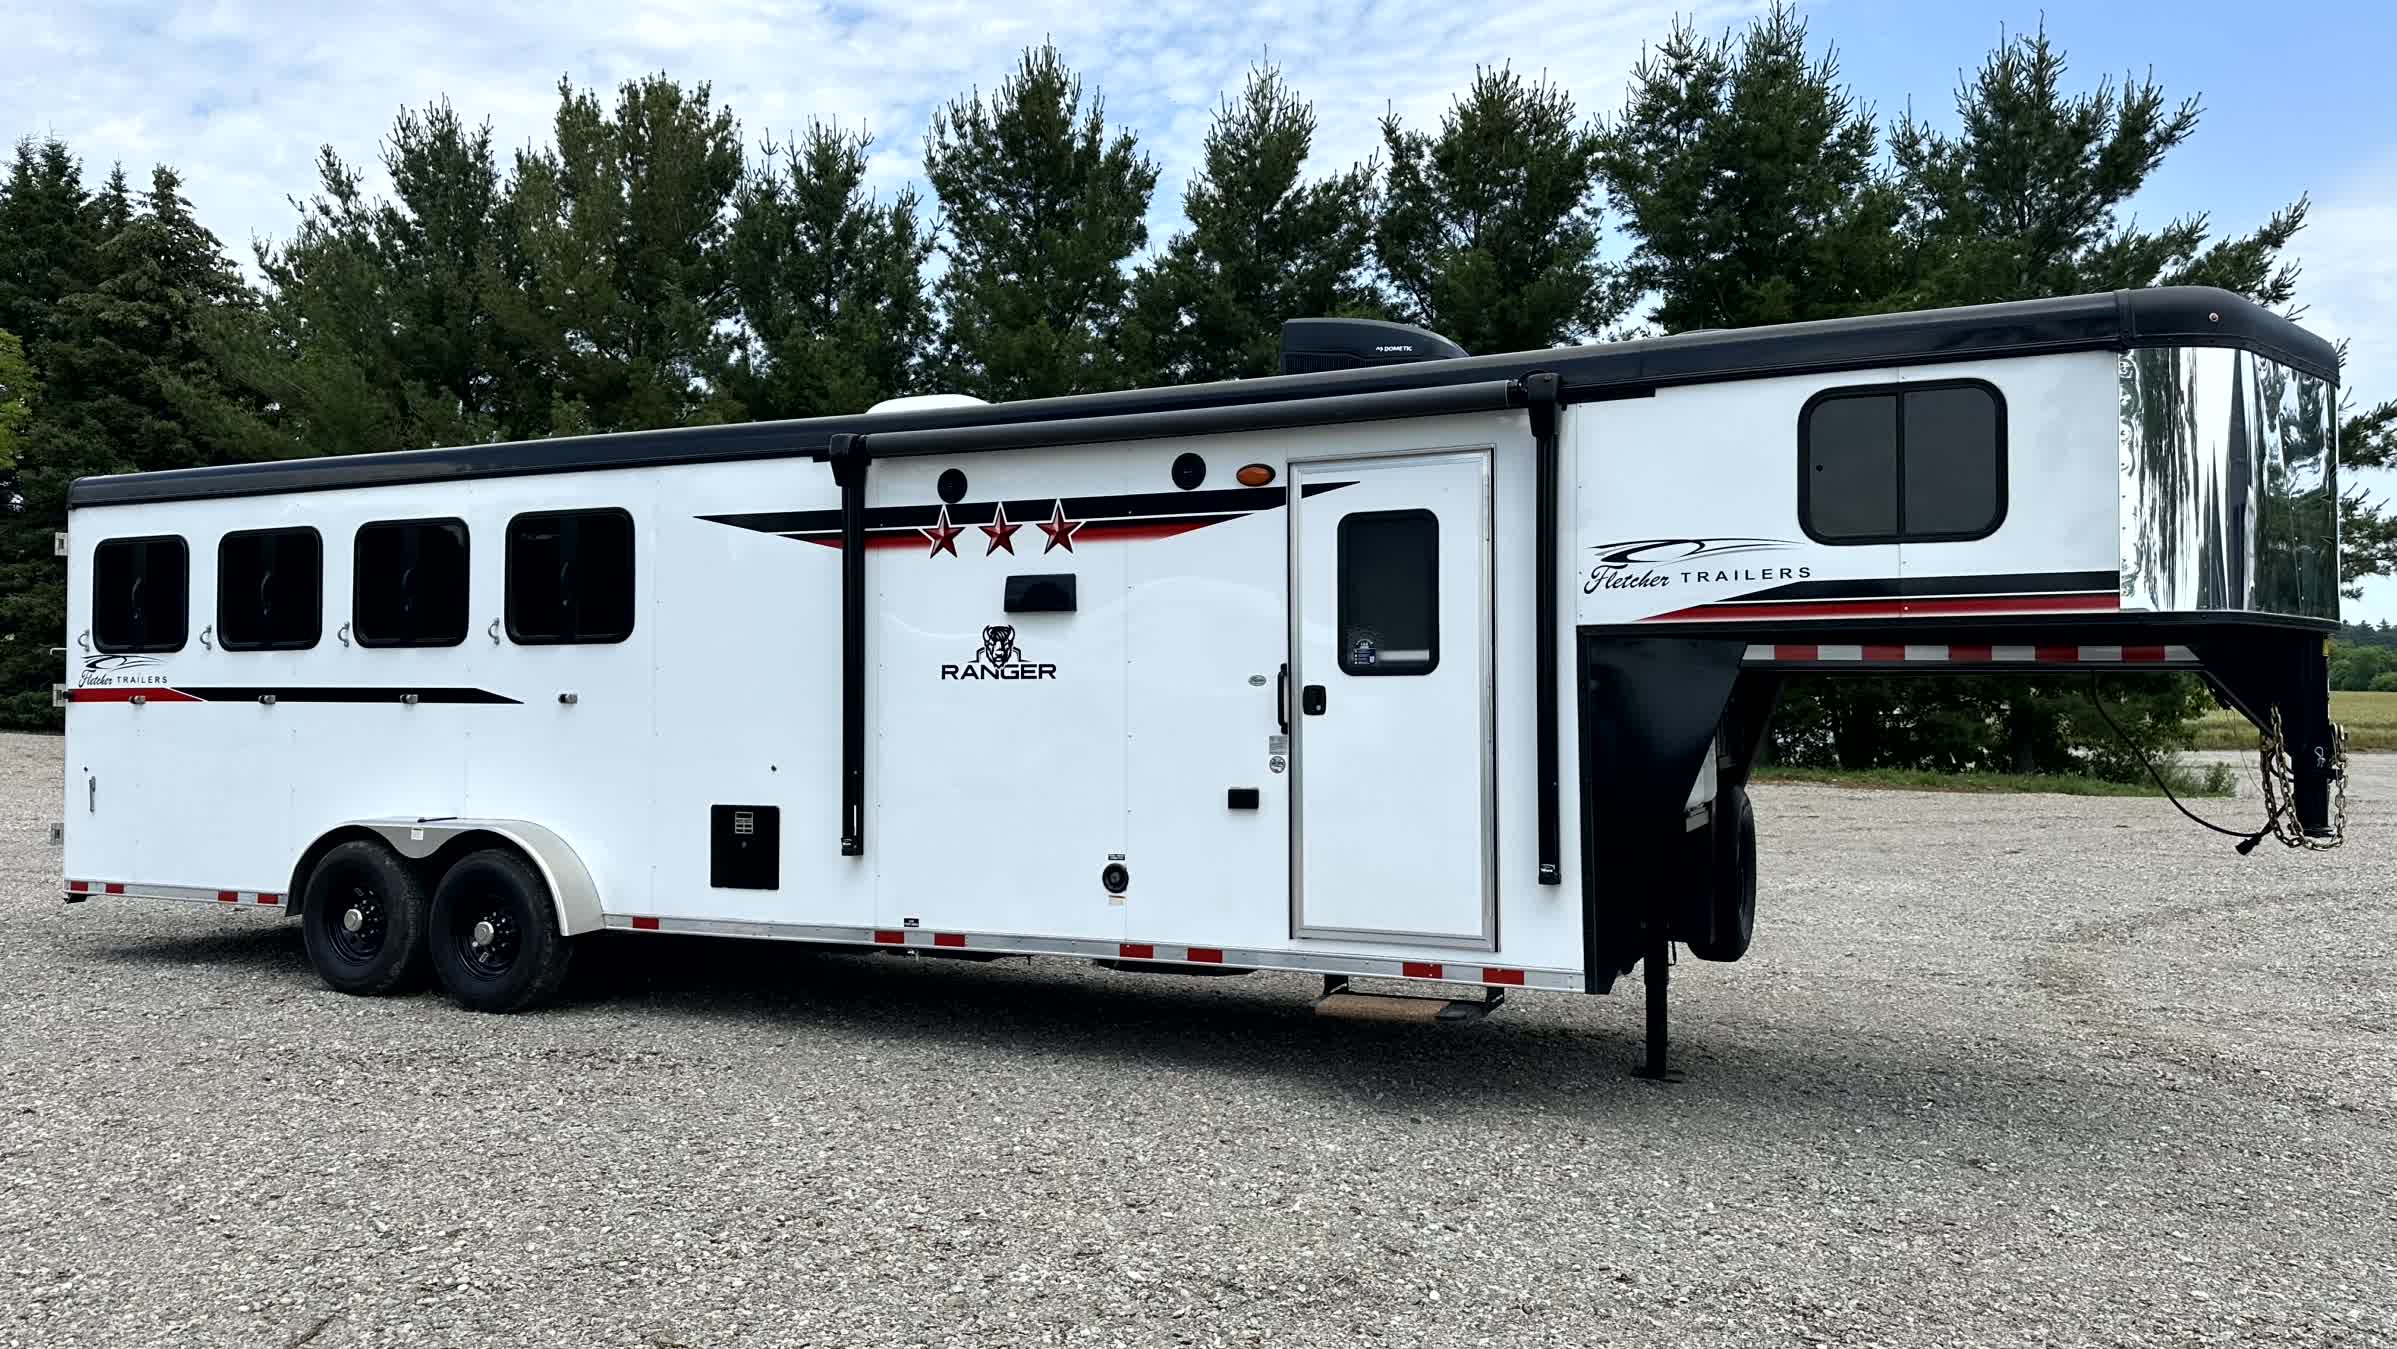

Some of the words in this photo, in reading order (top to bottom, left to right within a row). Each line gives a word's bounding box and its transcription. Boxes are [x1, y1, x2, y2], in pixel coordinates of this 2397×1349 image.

[1584, 564, 1669, 594] Fletcher
[1681, 567, 1810, 583] TRAILERS
[79, 669, 113, 687] Fletcher
[117, 675, 168, 684] TRAILERS
[941, 664, 1057, 680] RANGER
